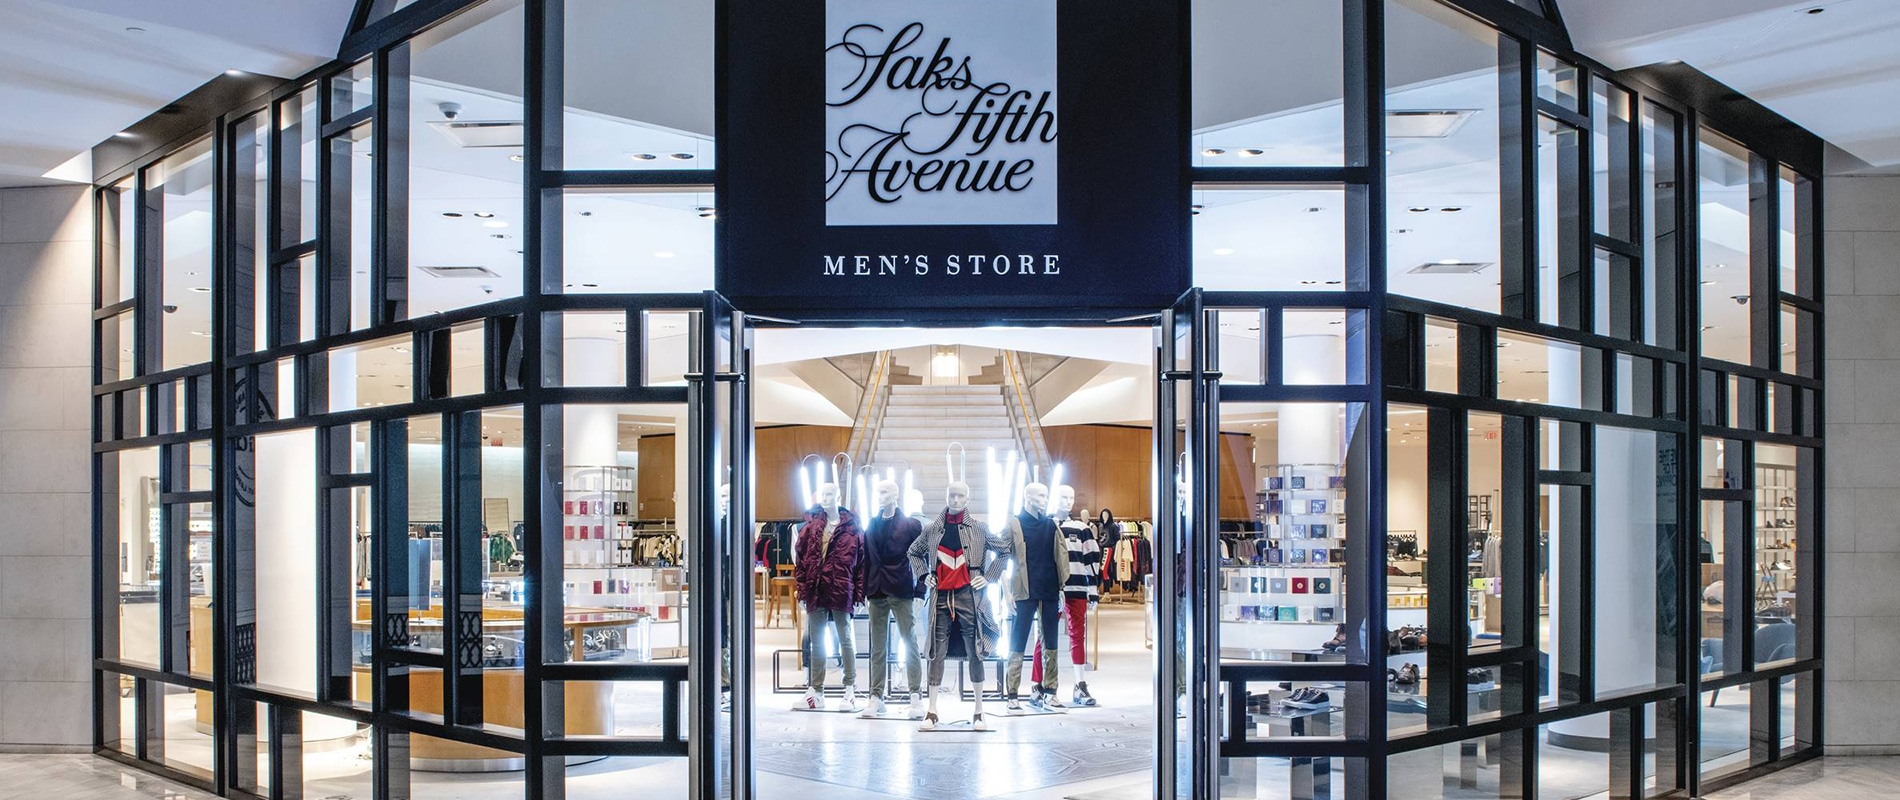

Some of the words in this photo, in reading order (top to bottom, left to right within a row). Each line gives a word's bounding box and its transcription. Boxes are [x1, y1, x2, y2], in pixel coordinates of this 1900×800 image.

[825, 22, 972, 107] Saks
[825, 123, 1034, 204] Avenue
[823, 255, 929, 276] MEN'S
[946, 254, 1060, 275] STORE
